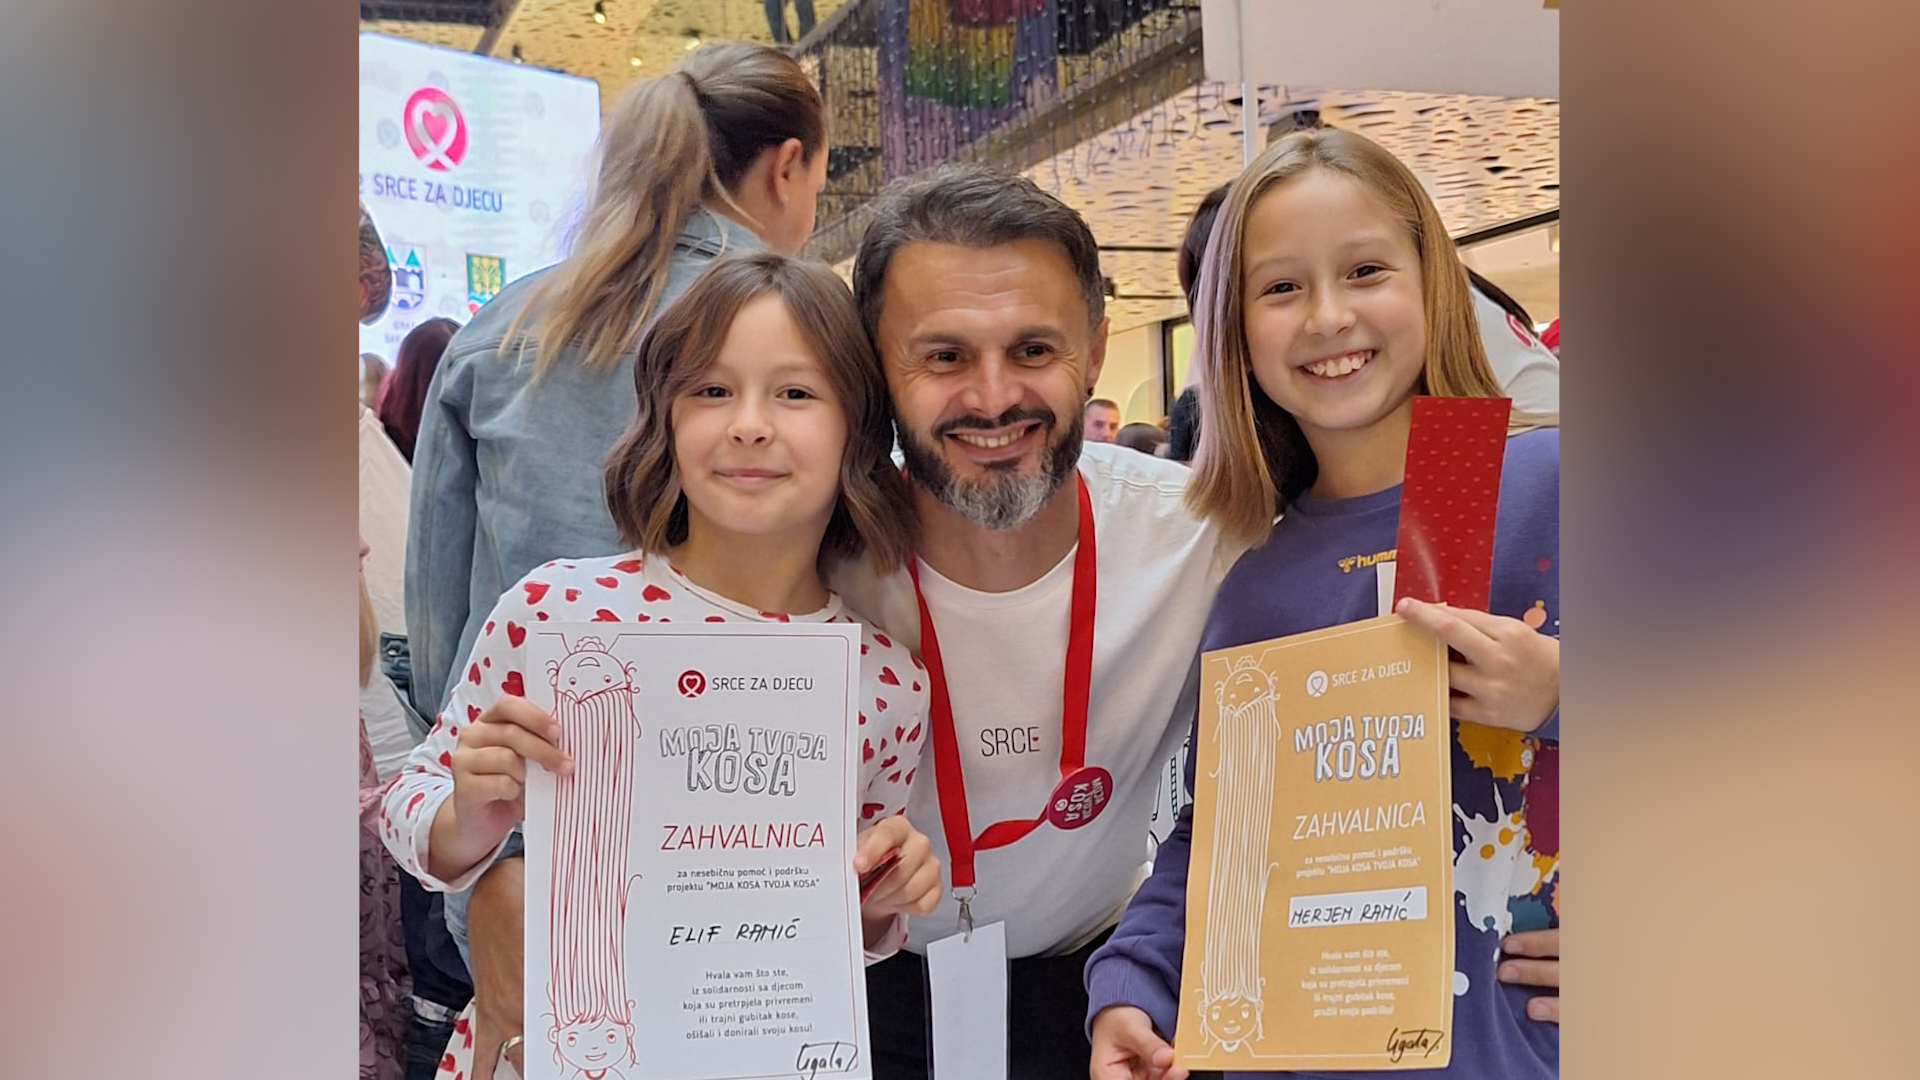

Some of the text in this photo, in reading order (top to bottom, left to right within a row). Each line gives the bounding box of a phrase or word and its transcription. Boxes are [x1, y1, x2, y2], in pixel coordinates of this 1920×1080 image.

[374, 173, 418, 200] SRCE
[424, 182, 447, 204] ZA
[453, 186, 503, 213] DJECU
[712, 677, 814, 691] SRCE ZA DJECU
[1331, 660, 1412, 687] SRCE ZA DJECU
[660, 723, 828, 760] MOJA TVOJA
[980, 726, 1041, 757] SRCE
[1294, 714, 1425, 753] MOJA TVOJA
[687, 748, 796, 796] KOSA
[1315, 737, 1400, 783] KOSA
[1064, 783, 1090, 822] KOSA
[1293, 800, 1426, 840] ZAHVALNICA
[661, 822, 826, 850] ZAHVALNICA
[667, 882, 704, 893] projektu
[737, 880, 760, 889] KOSA
[763, 880, 791, 889] TVOJA
[677, 870, 687, 878] za
[690, 869, 735, 878] nesebičnu
[737, 868, 766, 879] pomoć
[775, 867, 809, 877] podršku
[1291, 891, 1412, 925] MERJEM RAMIĆ
[669, 918, 801, 945] ELIF RAMIĆ
[705, 968, 789, 980] Hvala vam što ste,
[692, 981, 804, 995] iz solidarnosti sa djecom
[683, 1001, 702, 1011] koja
[719, 998, 762, 1010] pretrpjela
[765, 994, 813, 1007] privremeni
[686, 1029, 715, 1040] ošišali
[724, 1027, 759, 1038] donirali
[762, 1026, 786, 1036] svoju
[789, 1023, 813, 1034] kosu!
[699, 1011, 799, 1025] ili trajni gubitak kose,
